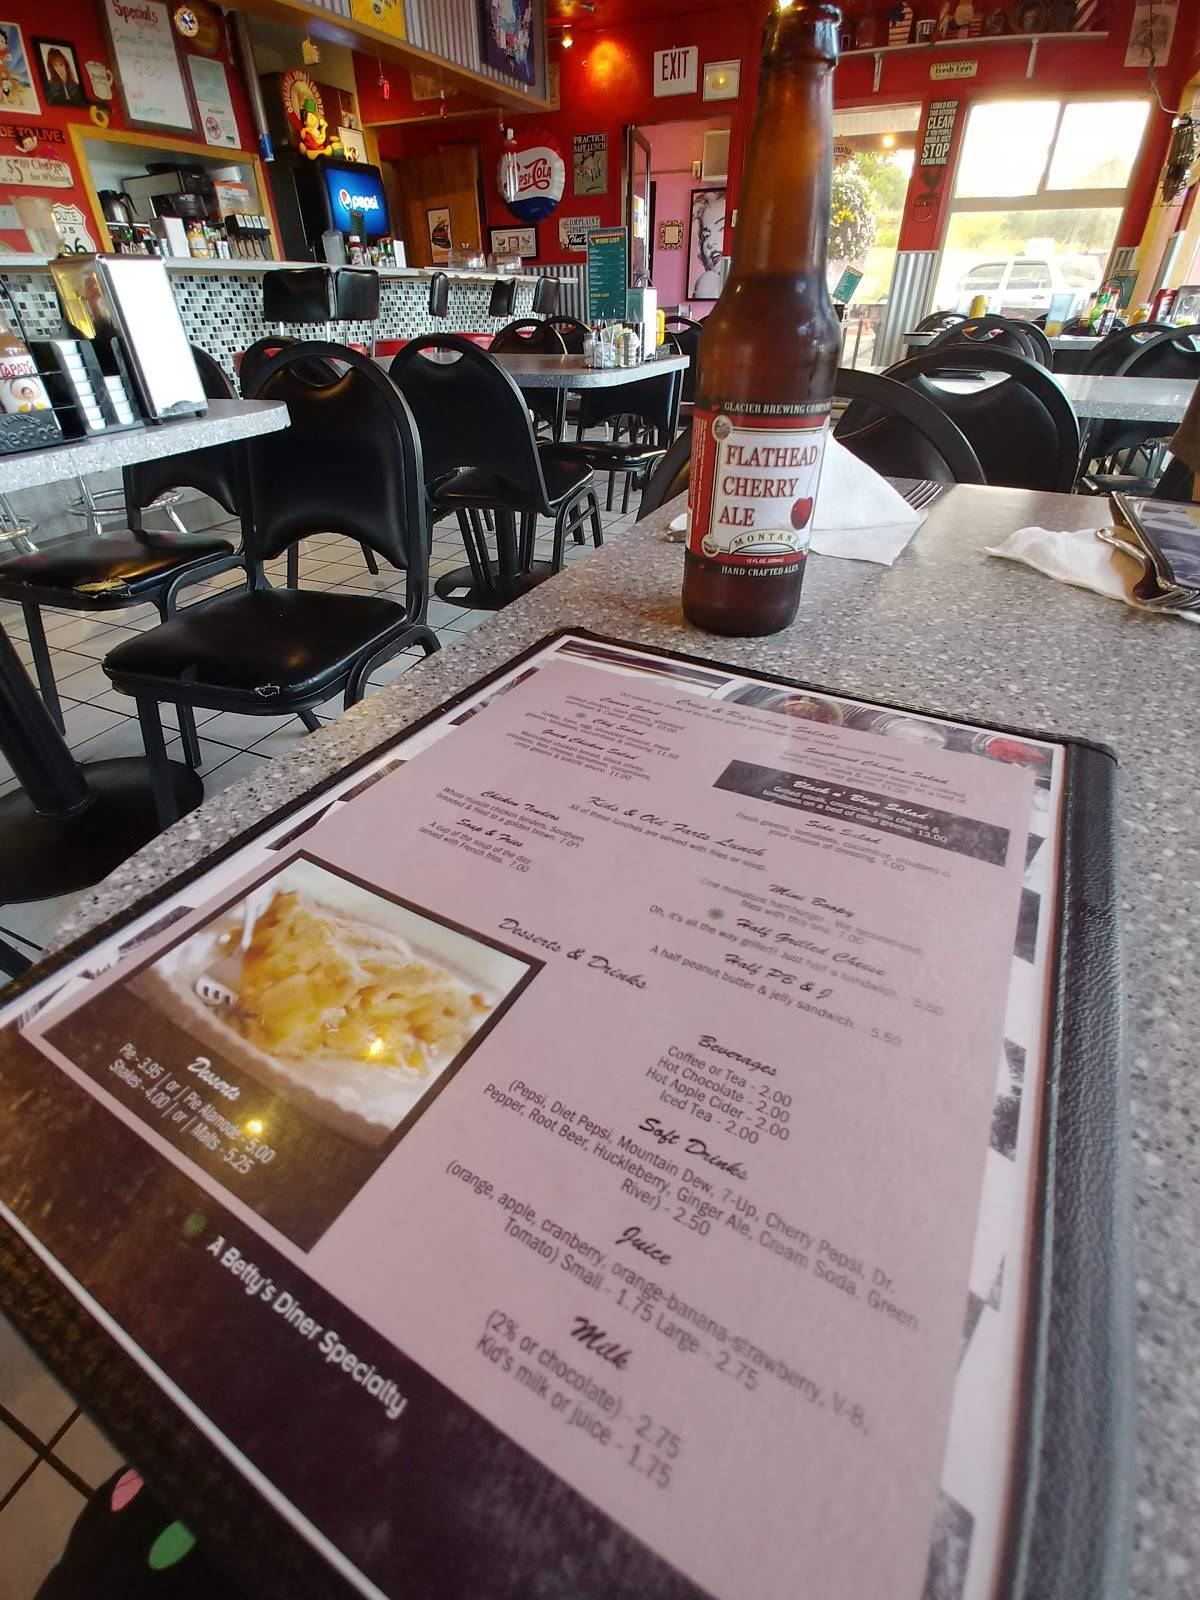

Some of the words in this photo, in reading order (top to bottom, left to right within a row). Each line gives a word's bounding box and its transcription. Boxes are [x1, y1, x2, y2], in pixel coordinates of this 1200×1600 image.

[661, 50, 690, 81] EXIT
[0, 126, 16, 138] DE
[573, 134, 606, 144] PRACTICE
[927, 116, 954, 129] CLEAN
[31, 159, 63, 174] Charge
[922, 143, 950, 158] STOP
[54, 211, 78, 221] OUTE
[352, 194, 379, 211] pepsi
[724, 402, 760, 414] GLACIER
[763, 404, 805, 414] BREWING
[726, 445, 818, 467] FLATHEAD
[723, 475, 800, 498] CHERRY
[719, 505, 755, 527] ALE
[734, 532, 799, 547] MONTANA
[721, 566, 745, 576] HAND
[748, 567, 782, 576] CRAFTED
[782, 564, 799, 574] ALES
[484, 829, 498, 837] &
[524, 803, 560, 821] Tenders
[588, 796, 619, 812] Kids
[623, 808, 638, 817] &
[639, 814, 669, 827] Old
[670, 823, 711, 841] Farts
[714, 838, 768, 857] Lunch
[884, 803, 930, 820] Salad
[498, 917, 561, 953] Desserts
[566, 947, 587, 961] &
[586, 955, 648, 990] Drinks
[737, 918, 771, 938] Half
[775, 932, 830, 956] Grilled
[832, 952, 886, 977] Cheese
[650, 945, 659, 954] A
[660, 948, 683, 963] half
[681, 956, 721, 979] peanut
[721, 972, 756, 993] butter
[757, 985, 767, 996] &
[768, 990, 793, 1006] jelly
[725, 953, 764, 977] Half
[765, 968, 798, 985] PB
[800, 982, 815, 993] &
[668, 1046, 706, 1069] Coffee
[709, 1065, 723, 1076] or
[725, 1069, 747, 1087] Tea
[759, 1085, 792, 1107] 2.00
[698, 1035, 777, 1076] Beverages
[187, 1056, 241, 1101] Desserts
[657, 1056, 680, 1074] Hot
[682, 1067, 744, 1102] Chocolate
[757, 1101, 790, 1123] 2.00
[109, 1058, 143, 1089] Shakes
[144, 1087, 171, 1109] 4.00
[172, 1110, 188, 1123] or
[191, 1123, 221, 1150] Malts
[223, 1149, 254, 1175] 5.25
[120, 1042, 137, 1060] Pie
[165, 1080, 182, 1092] or
[183, 1091, 202, 1111] Pie
[245, 1138, 277, 1164] 5.00
[645, 1067, 668, 1085] Hot
[669, 1079, 706, 1101] Apple
[709, 1095, 744, 1119] Cider
[755, 1117, 790, 1140] 2.00
[659, 1090, 688, 1110] Iced
[690, 1103, 713, 1122] Tea
[725, 1120, 759, 1144] 2.00
[638, 1117, 680, 1145] Soft
[685, 1138, 749, 1181] Drinks
[483, 1083, 525, 1117] Pepper,
[528, 1108, 558, 1131] Root
[558, 1124, 589, 1151] Beer,
[592, 1142, 672, 1197] Huckleberry,
[677, 1187, 725, 1219] Ginger
[726, 1213, 753, 1241] Ale,
[759, 1230, 809, 1269] Cream
[867, 1289, 919, 1331] Green
[508, 1079, 548, 1109] (Pepsi,
[550, 1100, 576, 1122] Diet
[577, 1114, 614, 1144] Pepsi,
[617, 1135, 679, 1176] Mountain
[681, 1168, 714, 1198] Dew,
[765, 1211, 814, 1250] Cherry
[818, 1239, 865, 1279] Pepsi,
[871, 1268, 896, 1294] Dr.
[620, 1178, 661, 1211] River)
[672, 1206, 711, 1237] 2.50
[446, 1159, 494, 1200] (orange,
[497, 1192, 537, 1226] apple,
[540, 1219, 607, 1269] cranberry,
[615, 1226, 672, 1266] Juice
[503, 1216, 560, 1264] Tomato)
[560, 1253, 603, 1291] Small
[616, 1288, 654, 1323] 1.75
[655, 1313, 700, 1353] Large
[715, 1350, 759, 1391] 2.75
[206, 1235, 226, 1257] A
[220, 1246, 277, 1302] Betty's
[272, 1291, 323, 1340] Diner
[318, 1330, 408, 1420] Specialty
[570, 1315, 632, 1371] Milk
[485, 1309, 519, 1343] (2%
[519, 1336, 539, 1355] or
[538, 1349, 623, 1421] chocolate)
[476, 1333, 515, 1373] Kid's
[515, 1365, 549, 1400] milk
[551, 1392, 572, 1411] or
[567, 1406, 612, 1446] juice
[628, 1443, 673, 1489] 1.75
